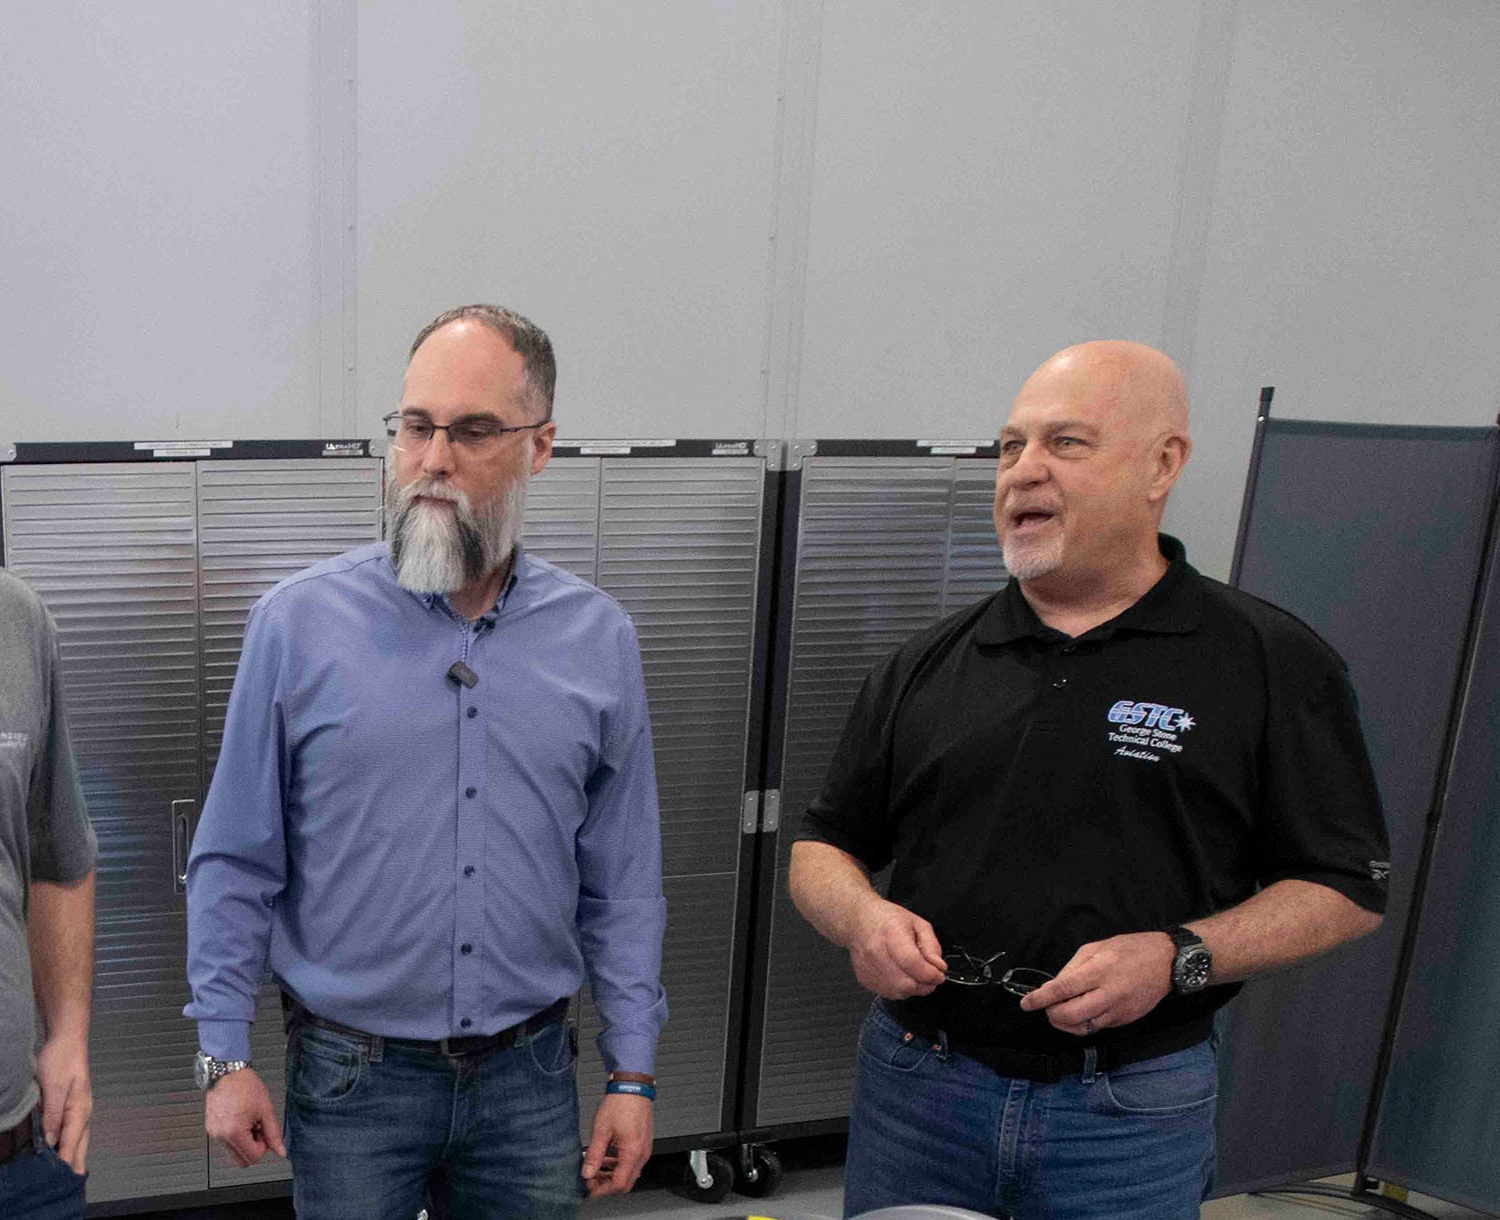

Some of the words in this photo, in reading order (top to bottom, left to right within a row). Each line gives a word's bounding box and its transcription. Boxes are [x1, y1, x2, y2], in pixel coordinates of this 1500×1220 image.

[1107, 700, 1184, 731] GSTC
[1108, 732, 1150, 746] Technical
[1150, 738, 1183, 753] College
[1119, 724, 1152, 737] George
[1152, 728, 1177, 741] Stone
